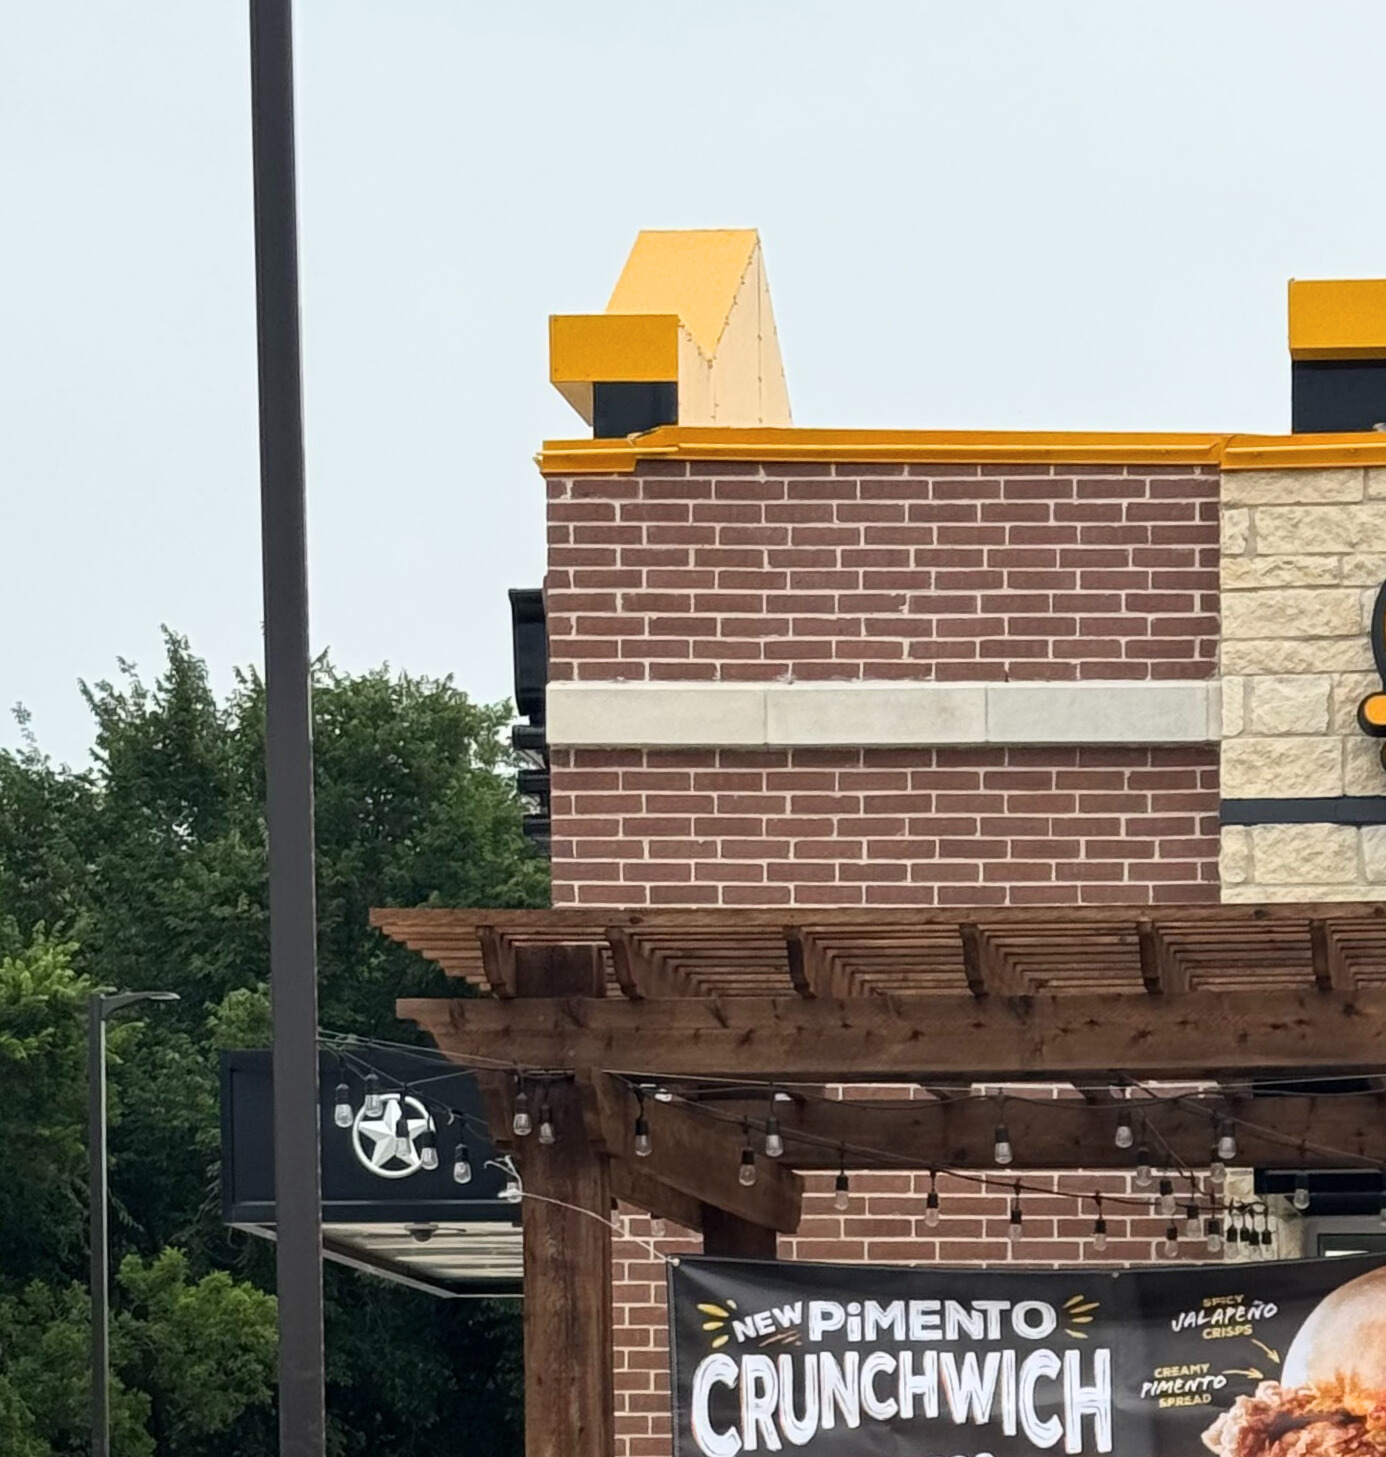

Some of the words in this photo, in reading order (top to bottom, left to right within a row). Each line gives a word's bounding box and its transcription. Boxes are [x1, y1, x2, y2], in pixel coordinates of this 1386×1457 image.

[1202, 1294, 1245, 1308] SPICY
[733, 1302, 803, 1343] NEW
[1171, 1300, 1279, 1333] JALAPEÑO
[1202, 1324, 1253, 1339] CRISPS
[1154, 1363, 1211, 1379] CREAMY
[1140, 1375, 1228, 1400] PIMENTO
[1158, 1393, 1212, 1409] SPREAD
